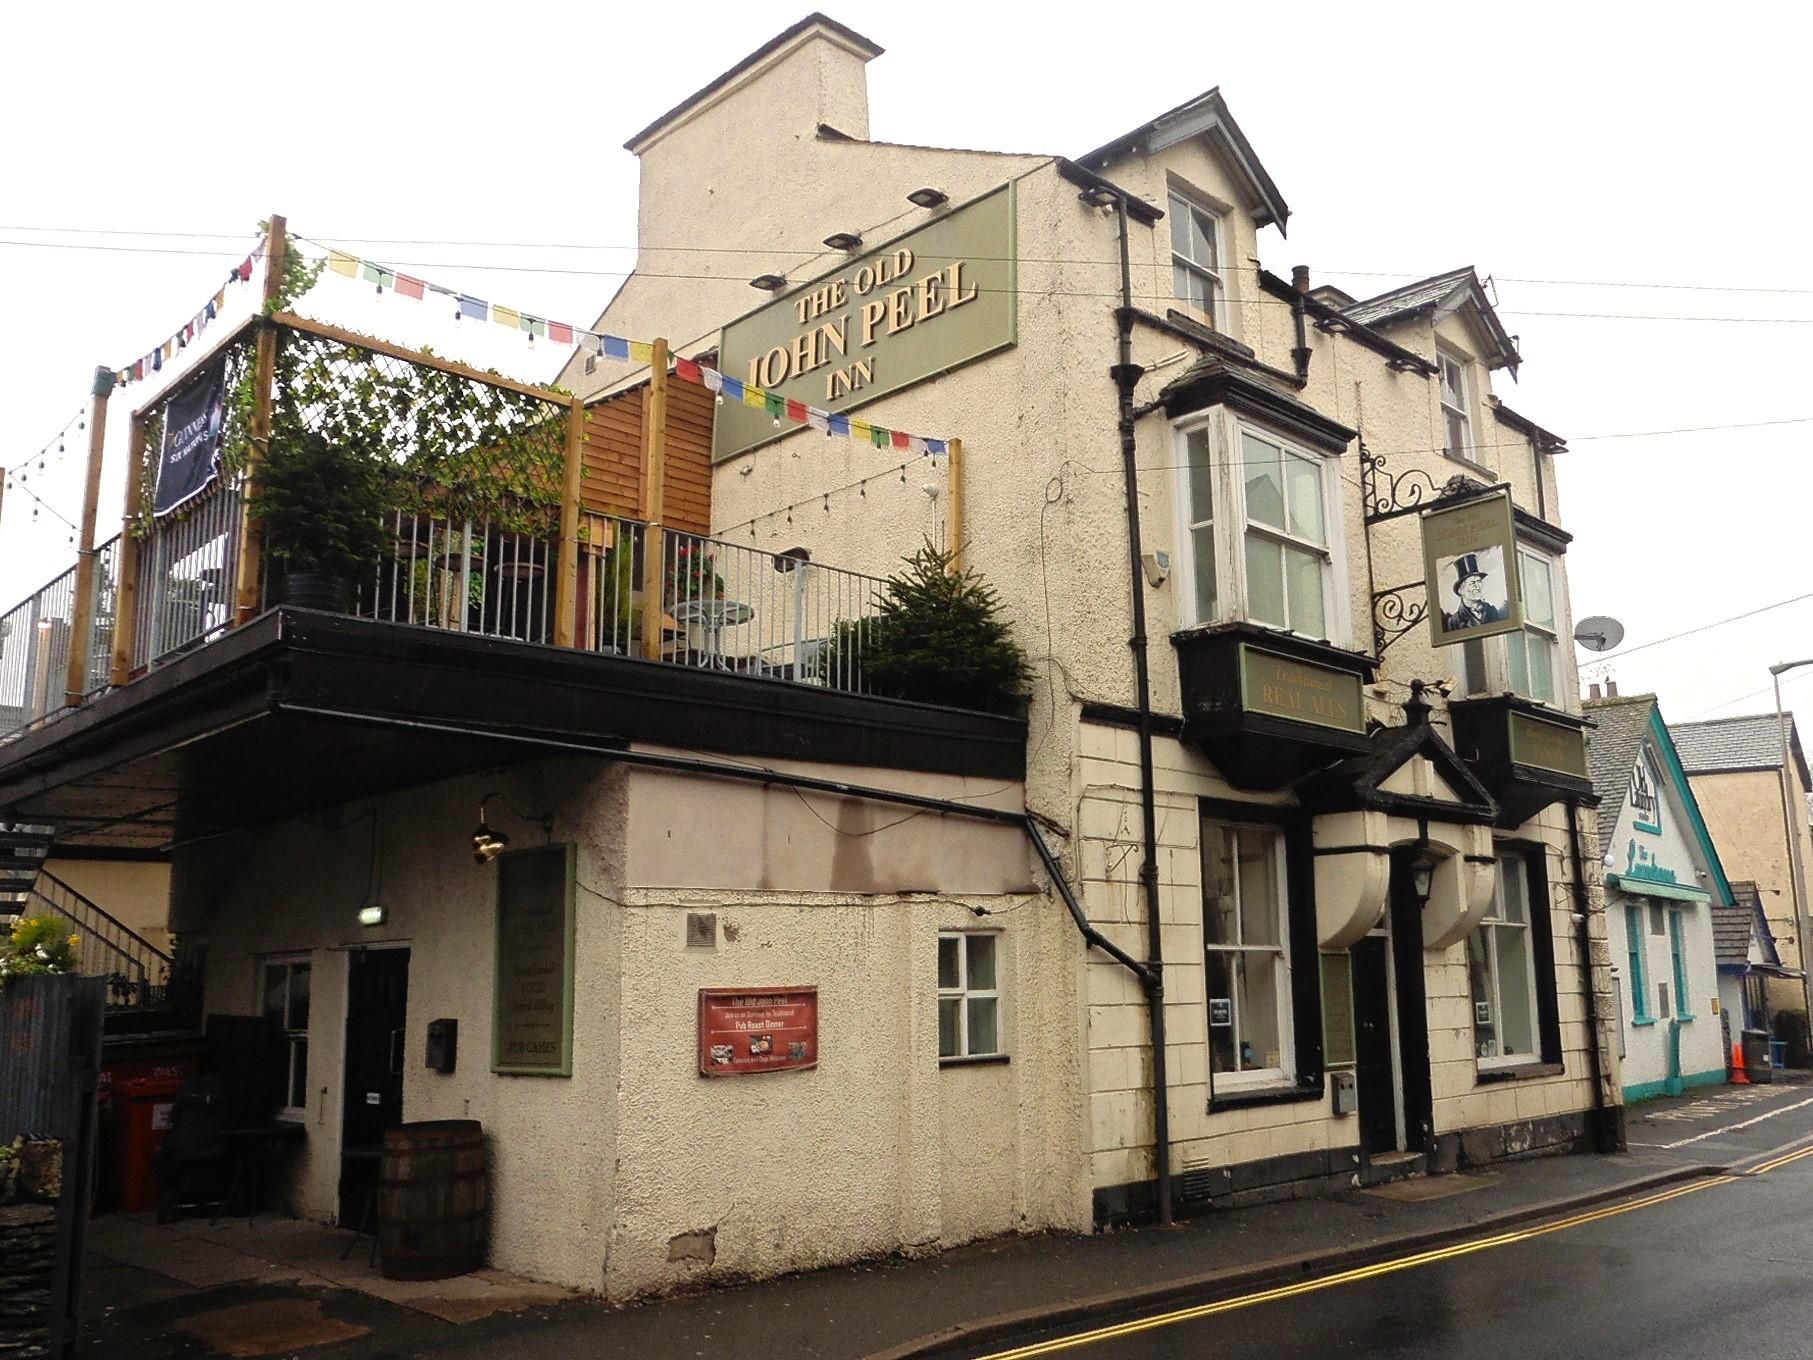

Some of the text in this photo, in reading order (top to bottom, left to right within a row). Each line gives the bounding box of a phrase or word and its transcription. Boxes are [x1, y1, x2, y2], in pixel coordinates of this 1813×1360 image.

[795, 248, 914, 324] THE OLD
[749, 260, 978, 389] JOHN PEEL
[826, 356, 875, 401] INN
[1263, 683, 1347, 720] REAL ALES
